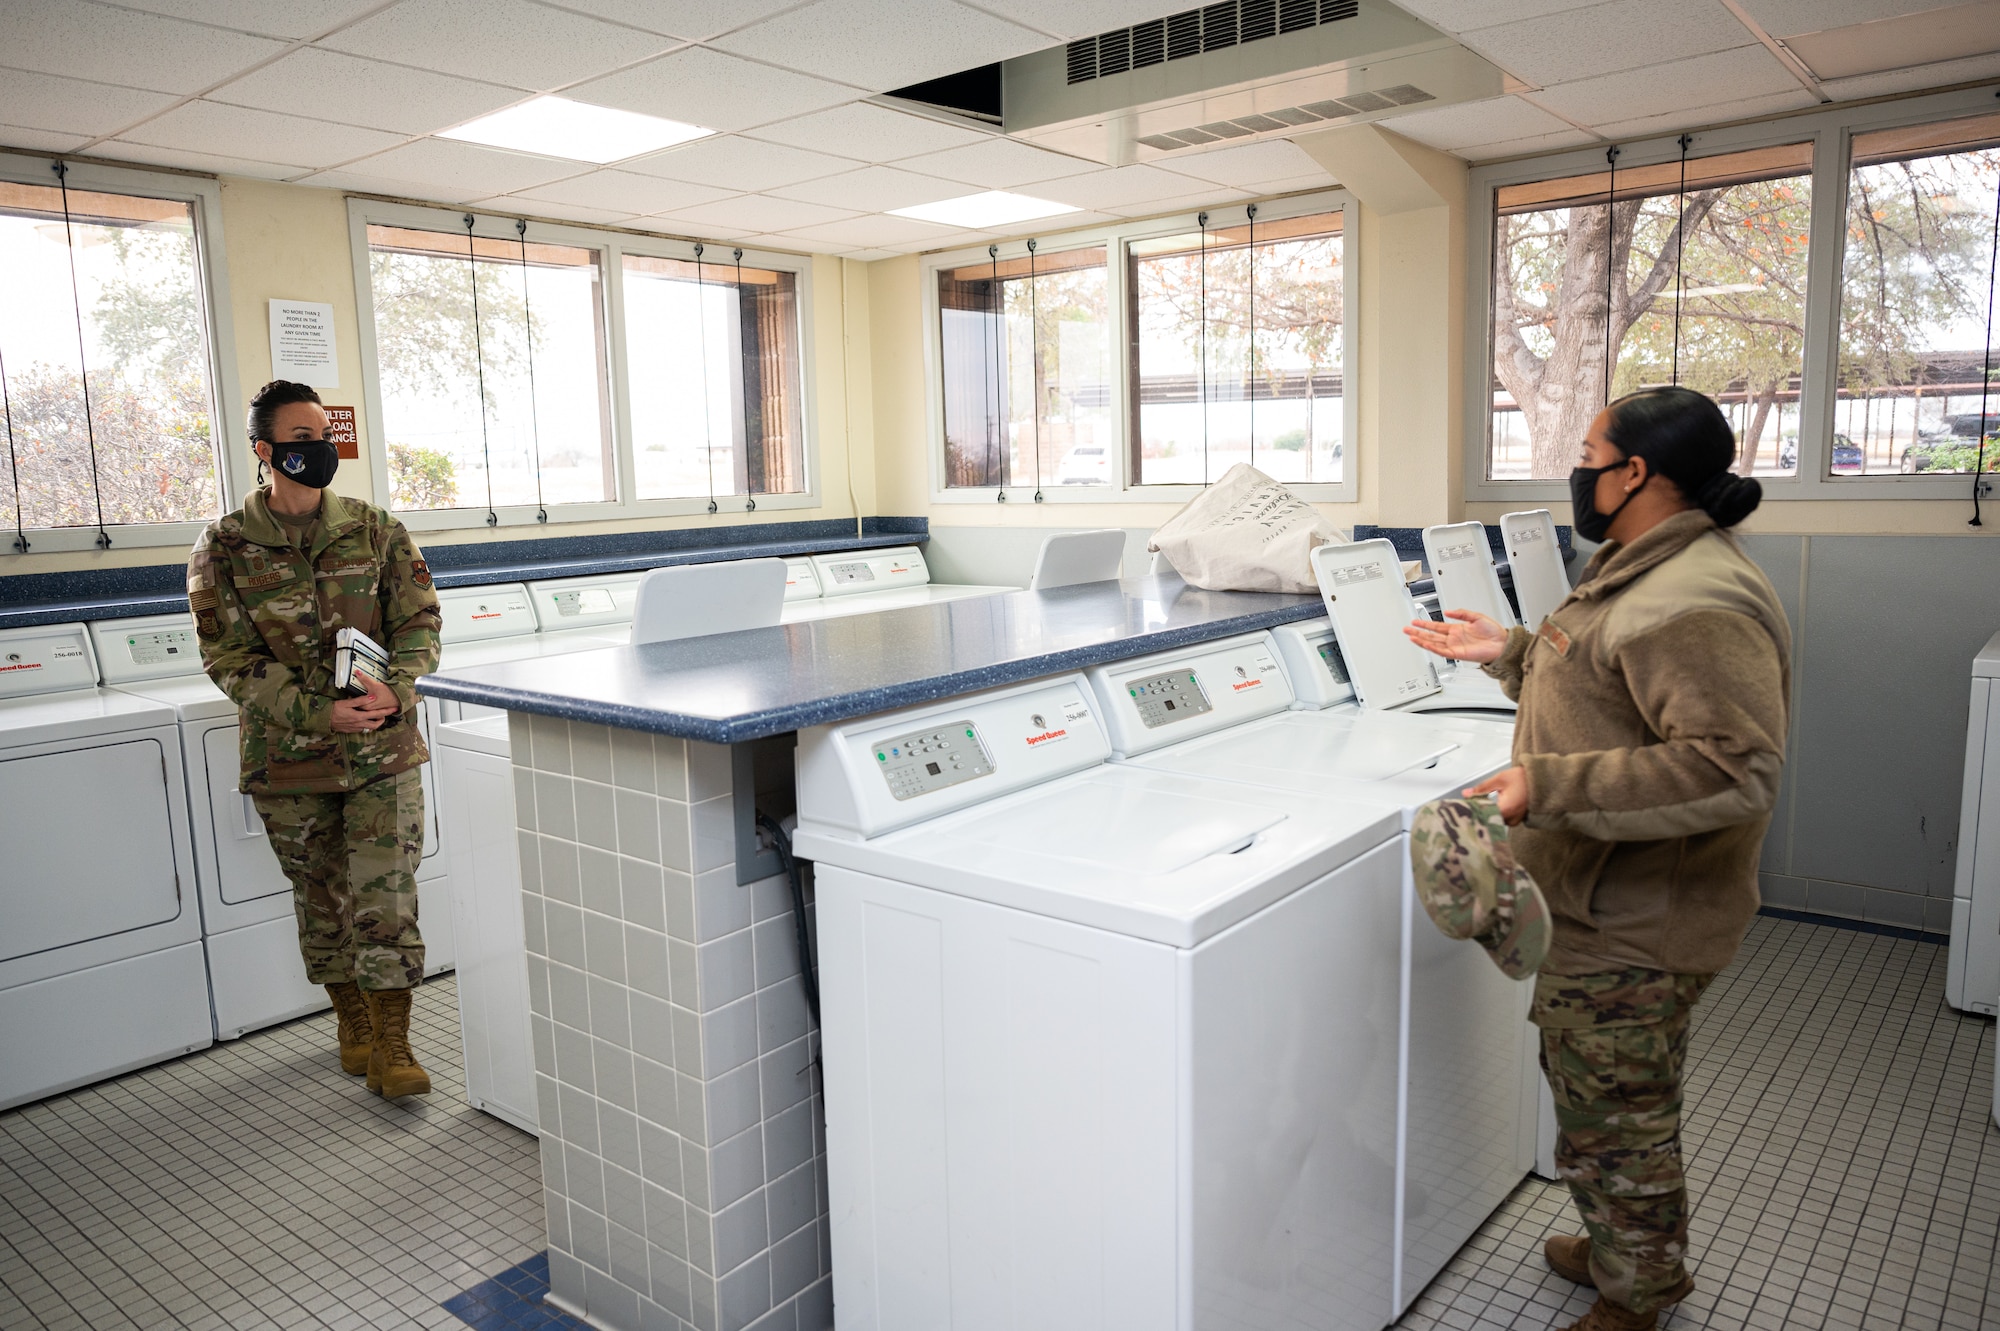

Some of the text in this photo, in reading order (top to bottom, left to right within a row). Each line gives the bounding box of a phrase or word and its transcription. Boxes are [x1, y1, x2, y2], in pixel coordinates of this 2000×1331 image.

[332, 421, 354, 432] OAD
[331, 433, 356, 443] ANCE
[248, 572, 281, 586] ROGERS
[1232, 681, 1247, 691] Speed
[1246, 679, 1262, 688] Queen
[1026, 733, 1047, 745] Speed
[1045, 729, 1067, 739] Queen
